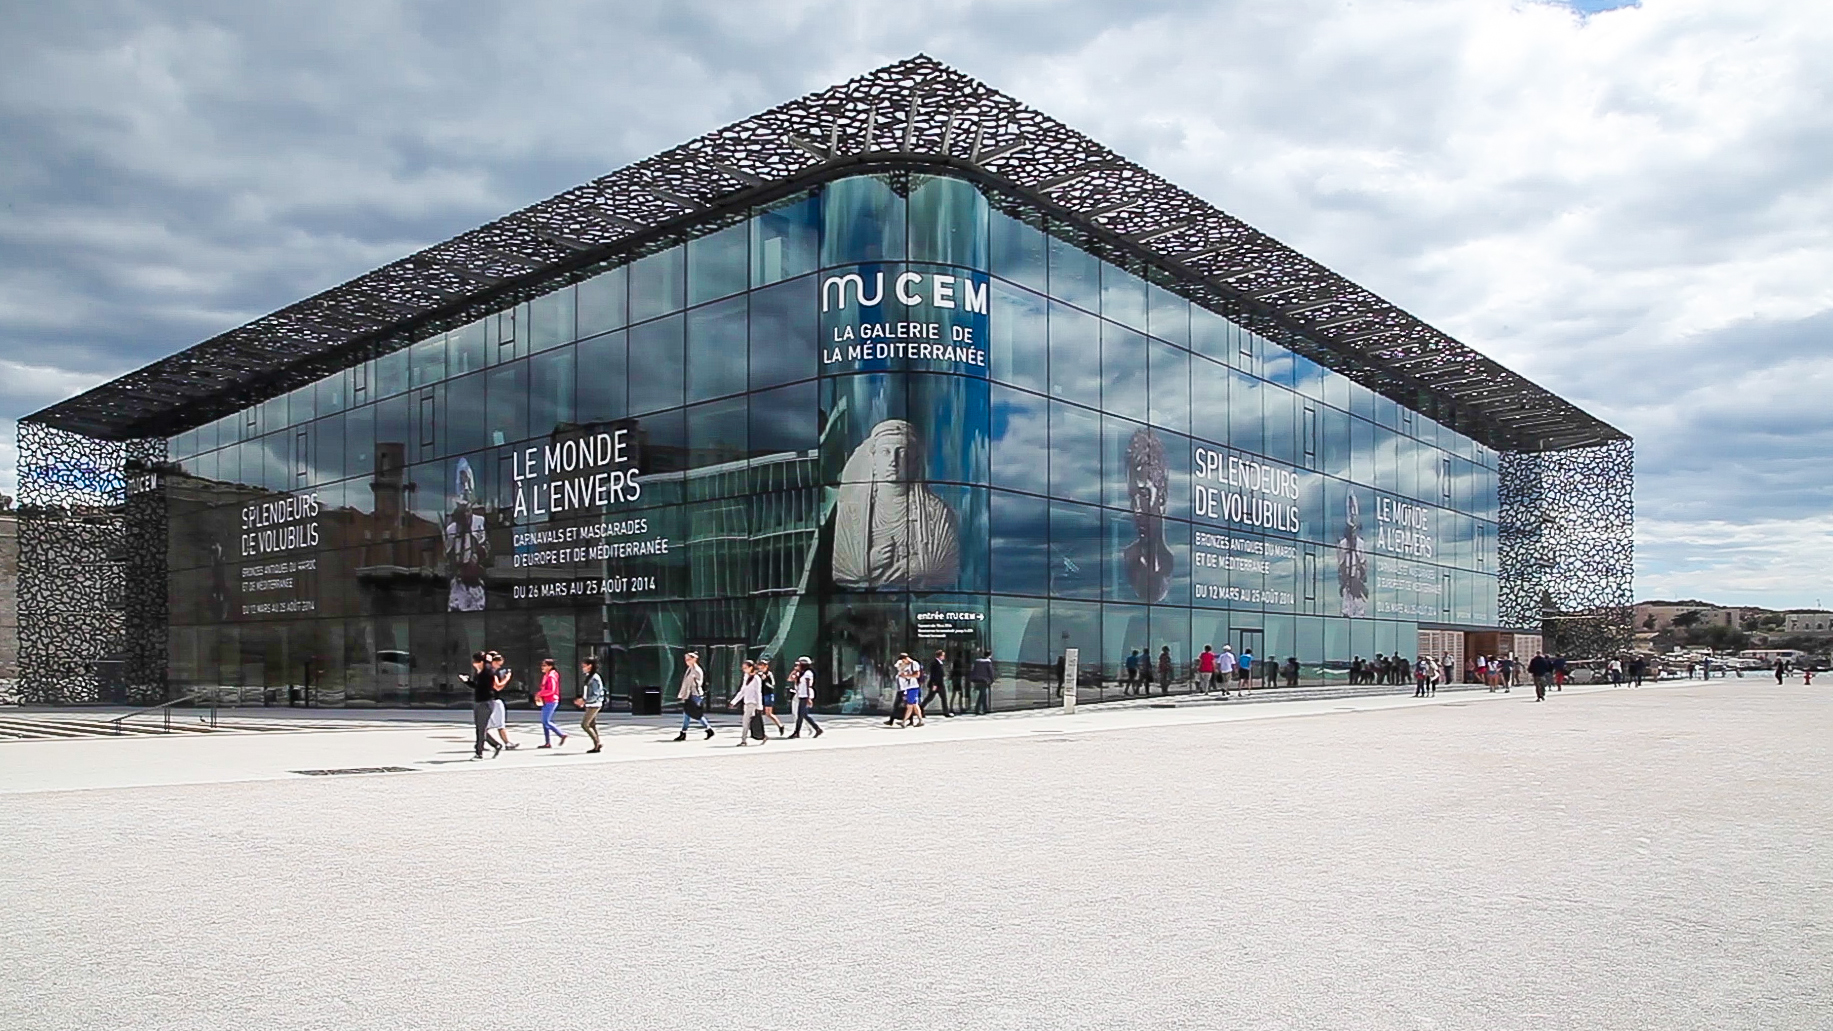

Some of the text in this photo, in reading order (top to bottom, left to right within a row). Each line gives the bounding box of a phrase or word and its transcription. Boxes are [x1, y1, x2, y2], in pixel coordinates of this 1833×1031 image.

[834, 322, 973, 343] LA GALERIE DE
[824, 340, 985, 366] LA MÉDITERRANÉE
[513, 429, 628, 481] LE MONDE
[1195, 447, 1299, 500] SPLENDEURS
[513, 468, 641, 518] À L'ENVERS
[1195, 485, 1299, 533] DE VOLUBILIS
[242, 493, 318, 529] SPLENDEURS
[1376, 496, 1428, 531] LE MONDE
[242, 522, 318, 556] DE VOLUBILIS
[513, 518, 648, 547] CARNAVALS ET MASCARADES
[560, 549, 571, 563] ET
[574, 547, 586, 562] DE
[589, 536, 669, 560] MÉDITERRANÉE
[513, 585, 526, 598] DU
[528, 585, 539, 598] 26
[541, 582, 567, 597] MARS
[570, 581, 584, 595] AU
[586, 580, 598, 594] 25
[631, 576, 656, 592] 2014
[1195, 584, 1207, 598] DU
[1208, 585, 1218, 599] 12
